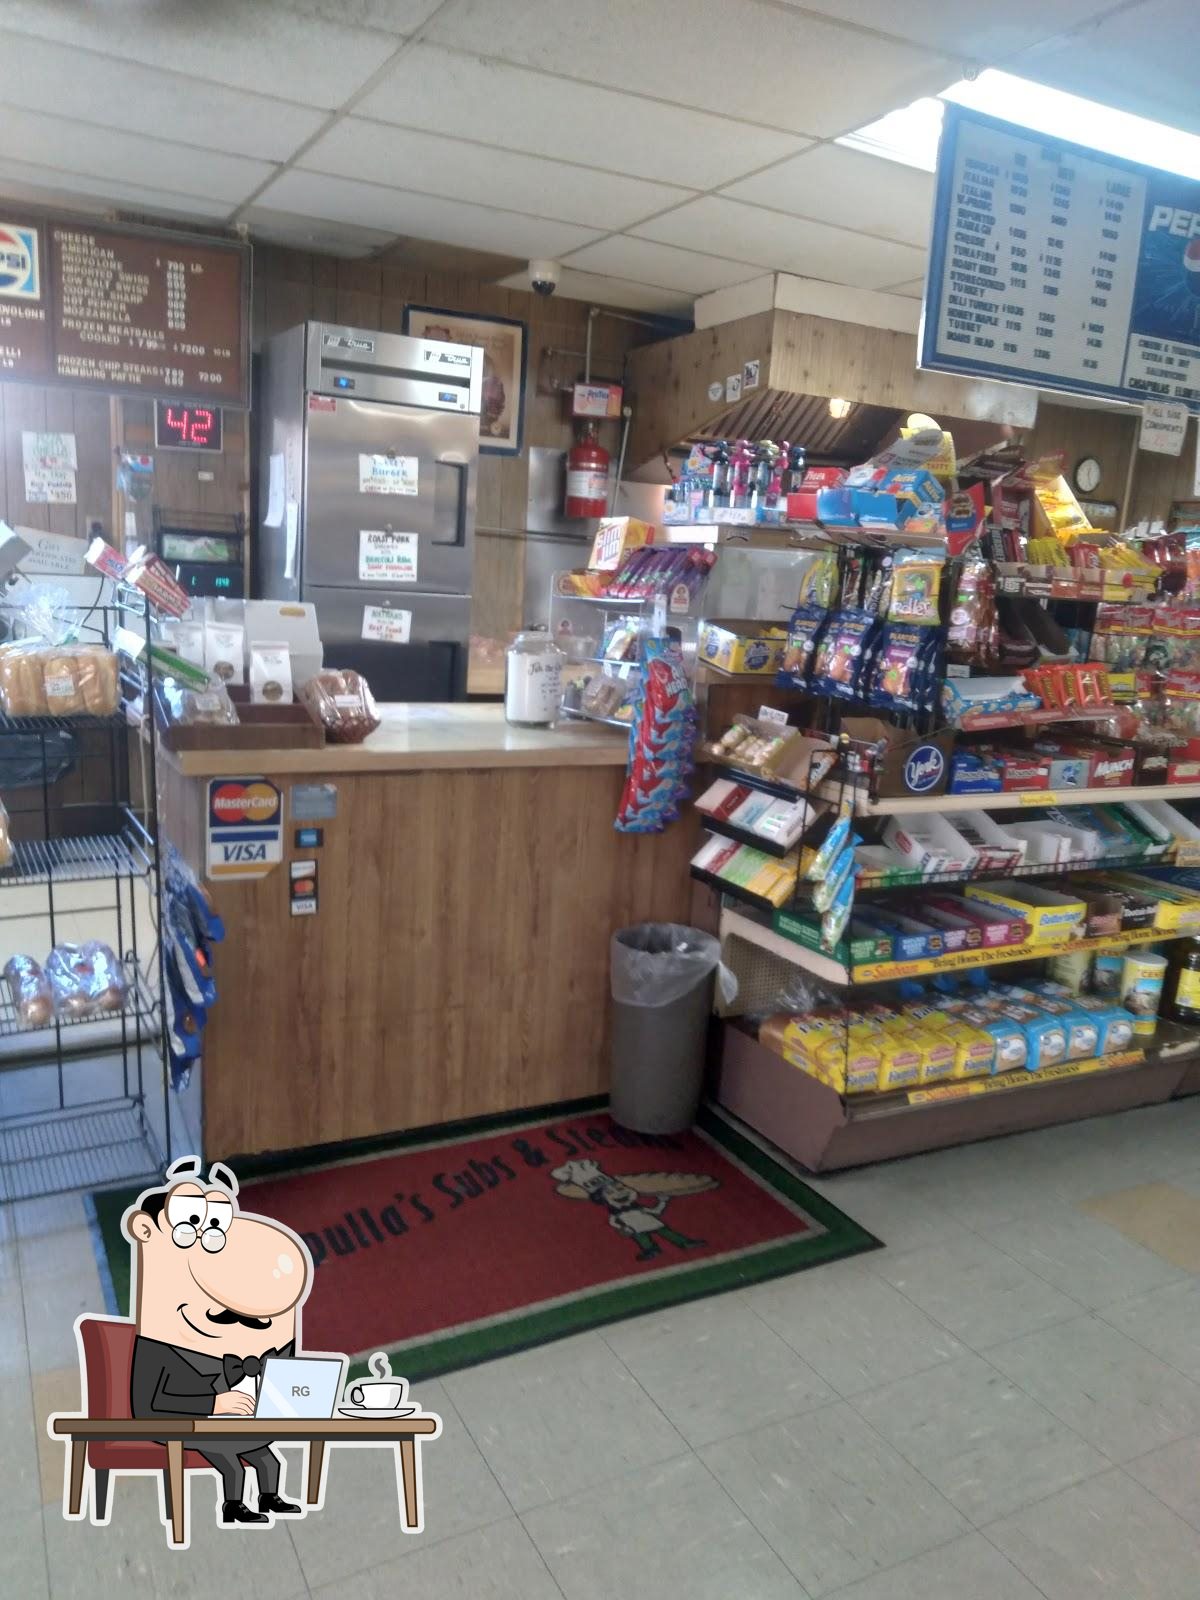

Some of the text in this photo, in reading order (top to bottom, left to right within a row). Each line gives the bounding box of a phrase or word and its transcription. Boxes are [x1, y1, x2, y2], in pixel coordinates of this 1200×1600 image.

[54, 230, 96, 246] CHEESE
[61, 242, 115, 260] AMERICAN
[62, 318, 166, 341] FROZEN MEATBALLS
[57, 354, 96, 369] FROZEN
[98, 359, 120, 370] CHIP
[166, 408, 213, 444] 42
[214, 797, 277, 810] MasterCard
[223, 843, 267, 862] VISA
[432, 1157, 517, 1208] Subs
[513, 1138, 550, 1168] &
